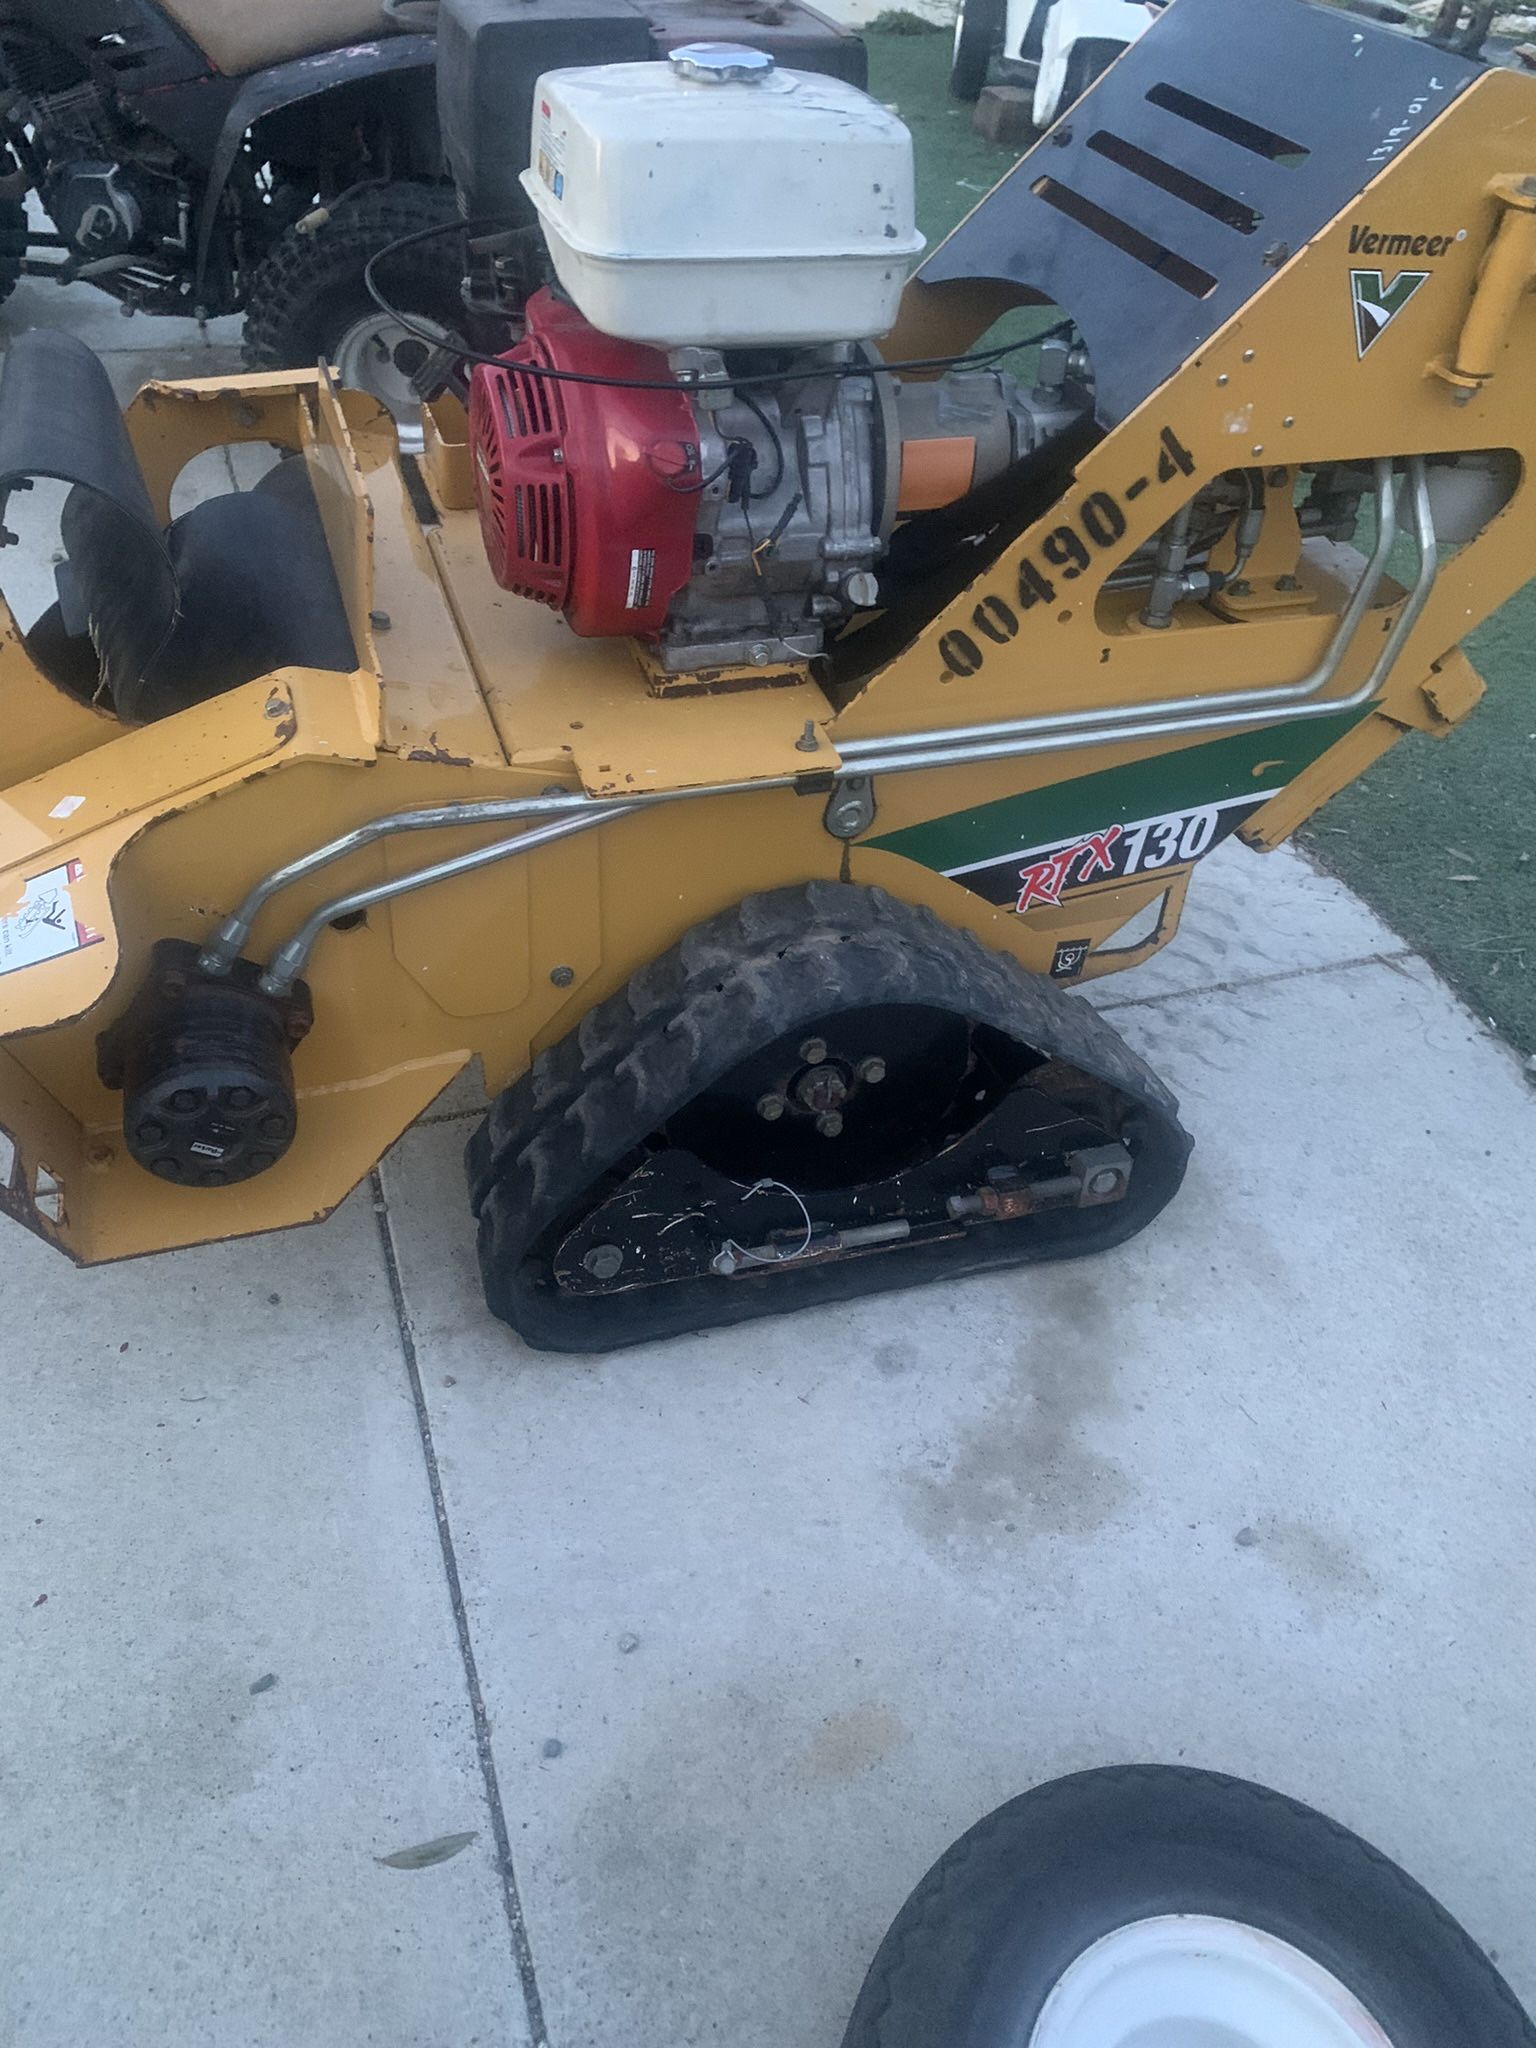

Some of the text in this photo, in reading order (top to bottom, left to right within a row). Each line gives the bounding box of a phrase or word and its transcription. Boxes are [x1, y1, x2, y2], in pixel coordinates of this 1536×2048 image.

[1348, 224, 1455, 257] Vermeer
[938, 426, 1196, 678] 00490-4
[1016, 809, 1219, 914] RTX 130
